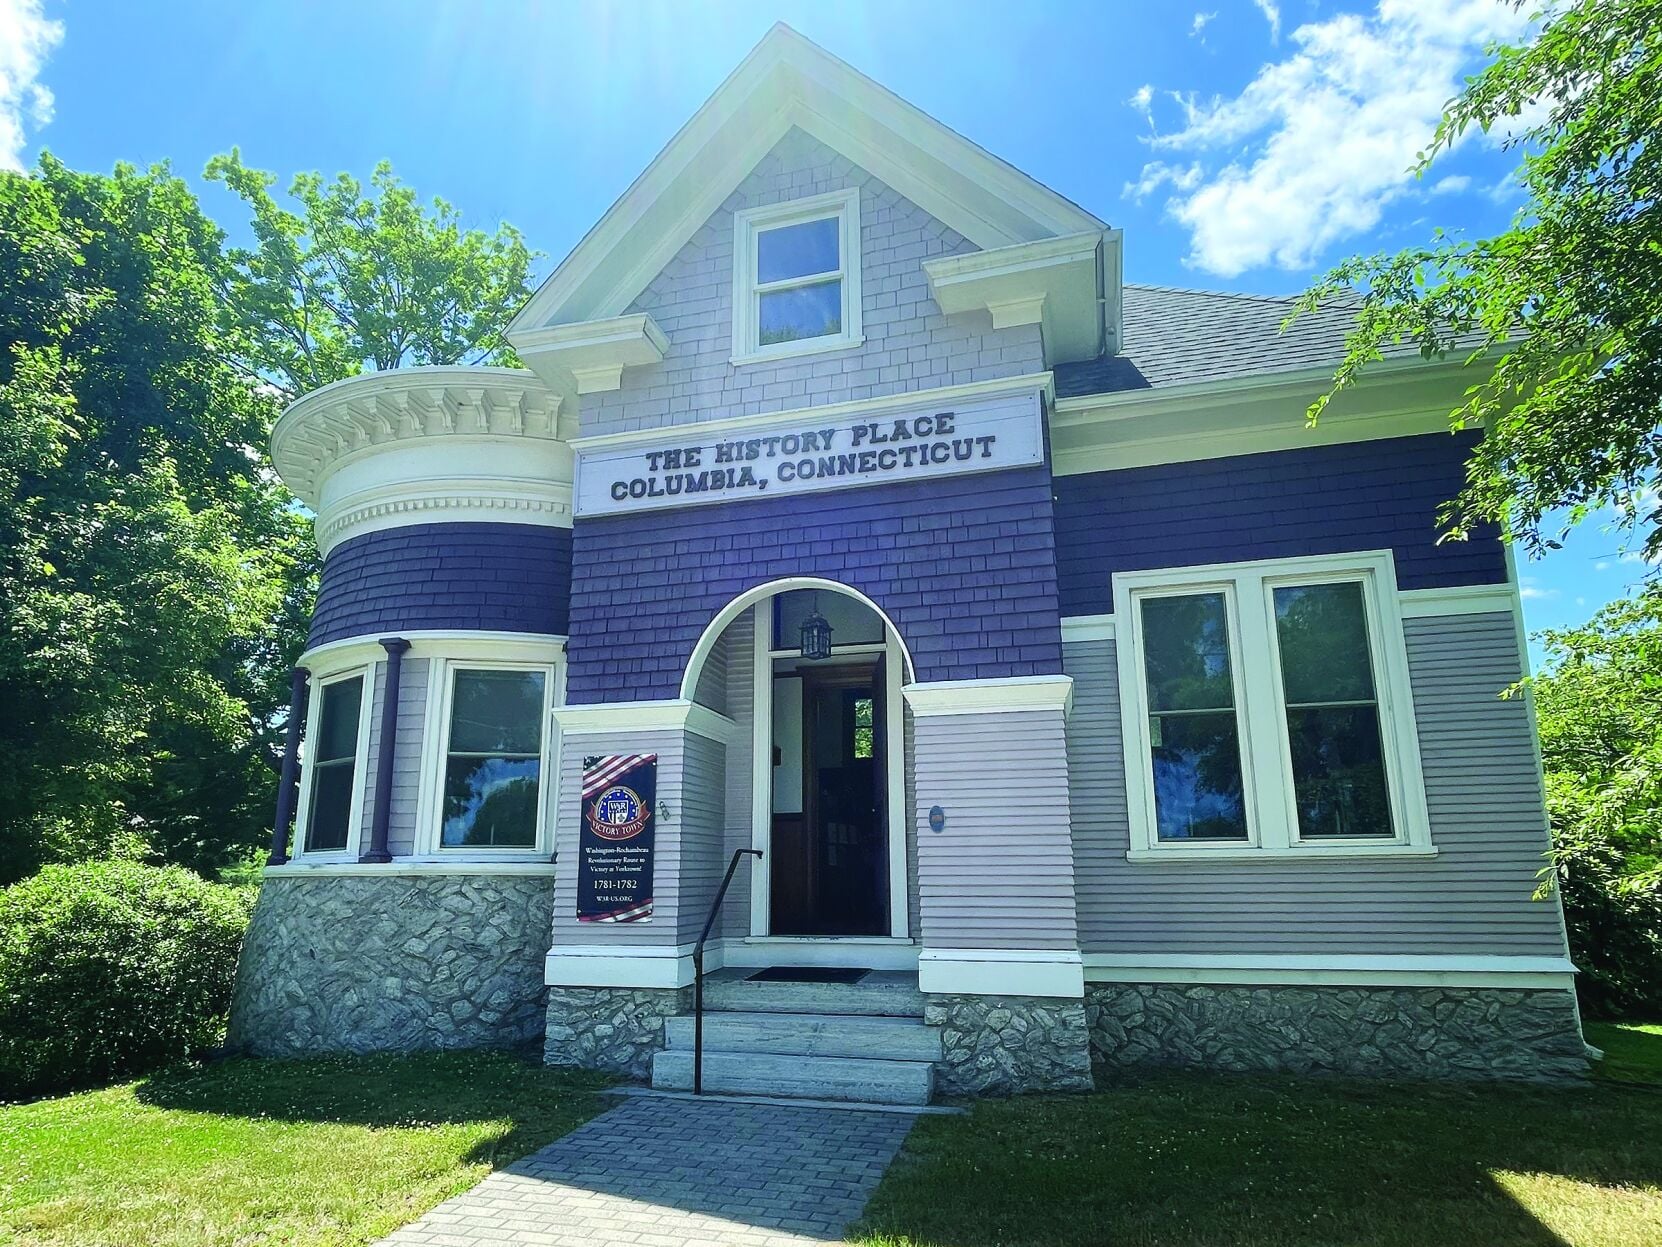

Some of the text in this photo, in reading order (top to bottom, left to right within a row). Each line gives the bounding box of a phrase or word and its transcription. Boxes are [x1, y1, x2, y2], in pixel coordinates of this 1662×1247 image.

[645, 412, 955, 471] THE HISTORY PLACE
[610, 435, 996, 500] COLUMBIA, CONNECTICUT
[592, 820, 643, 835] VICTORY TOWN
[585, 846, 649, 855] Washington-Rochambeau
[594, 879, 638, 889] 1781-1782
